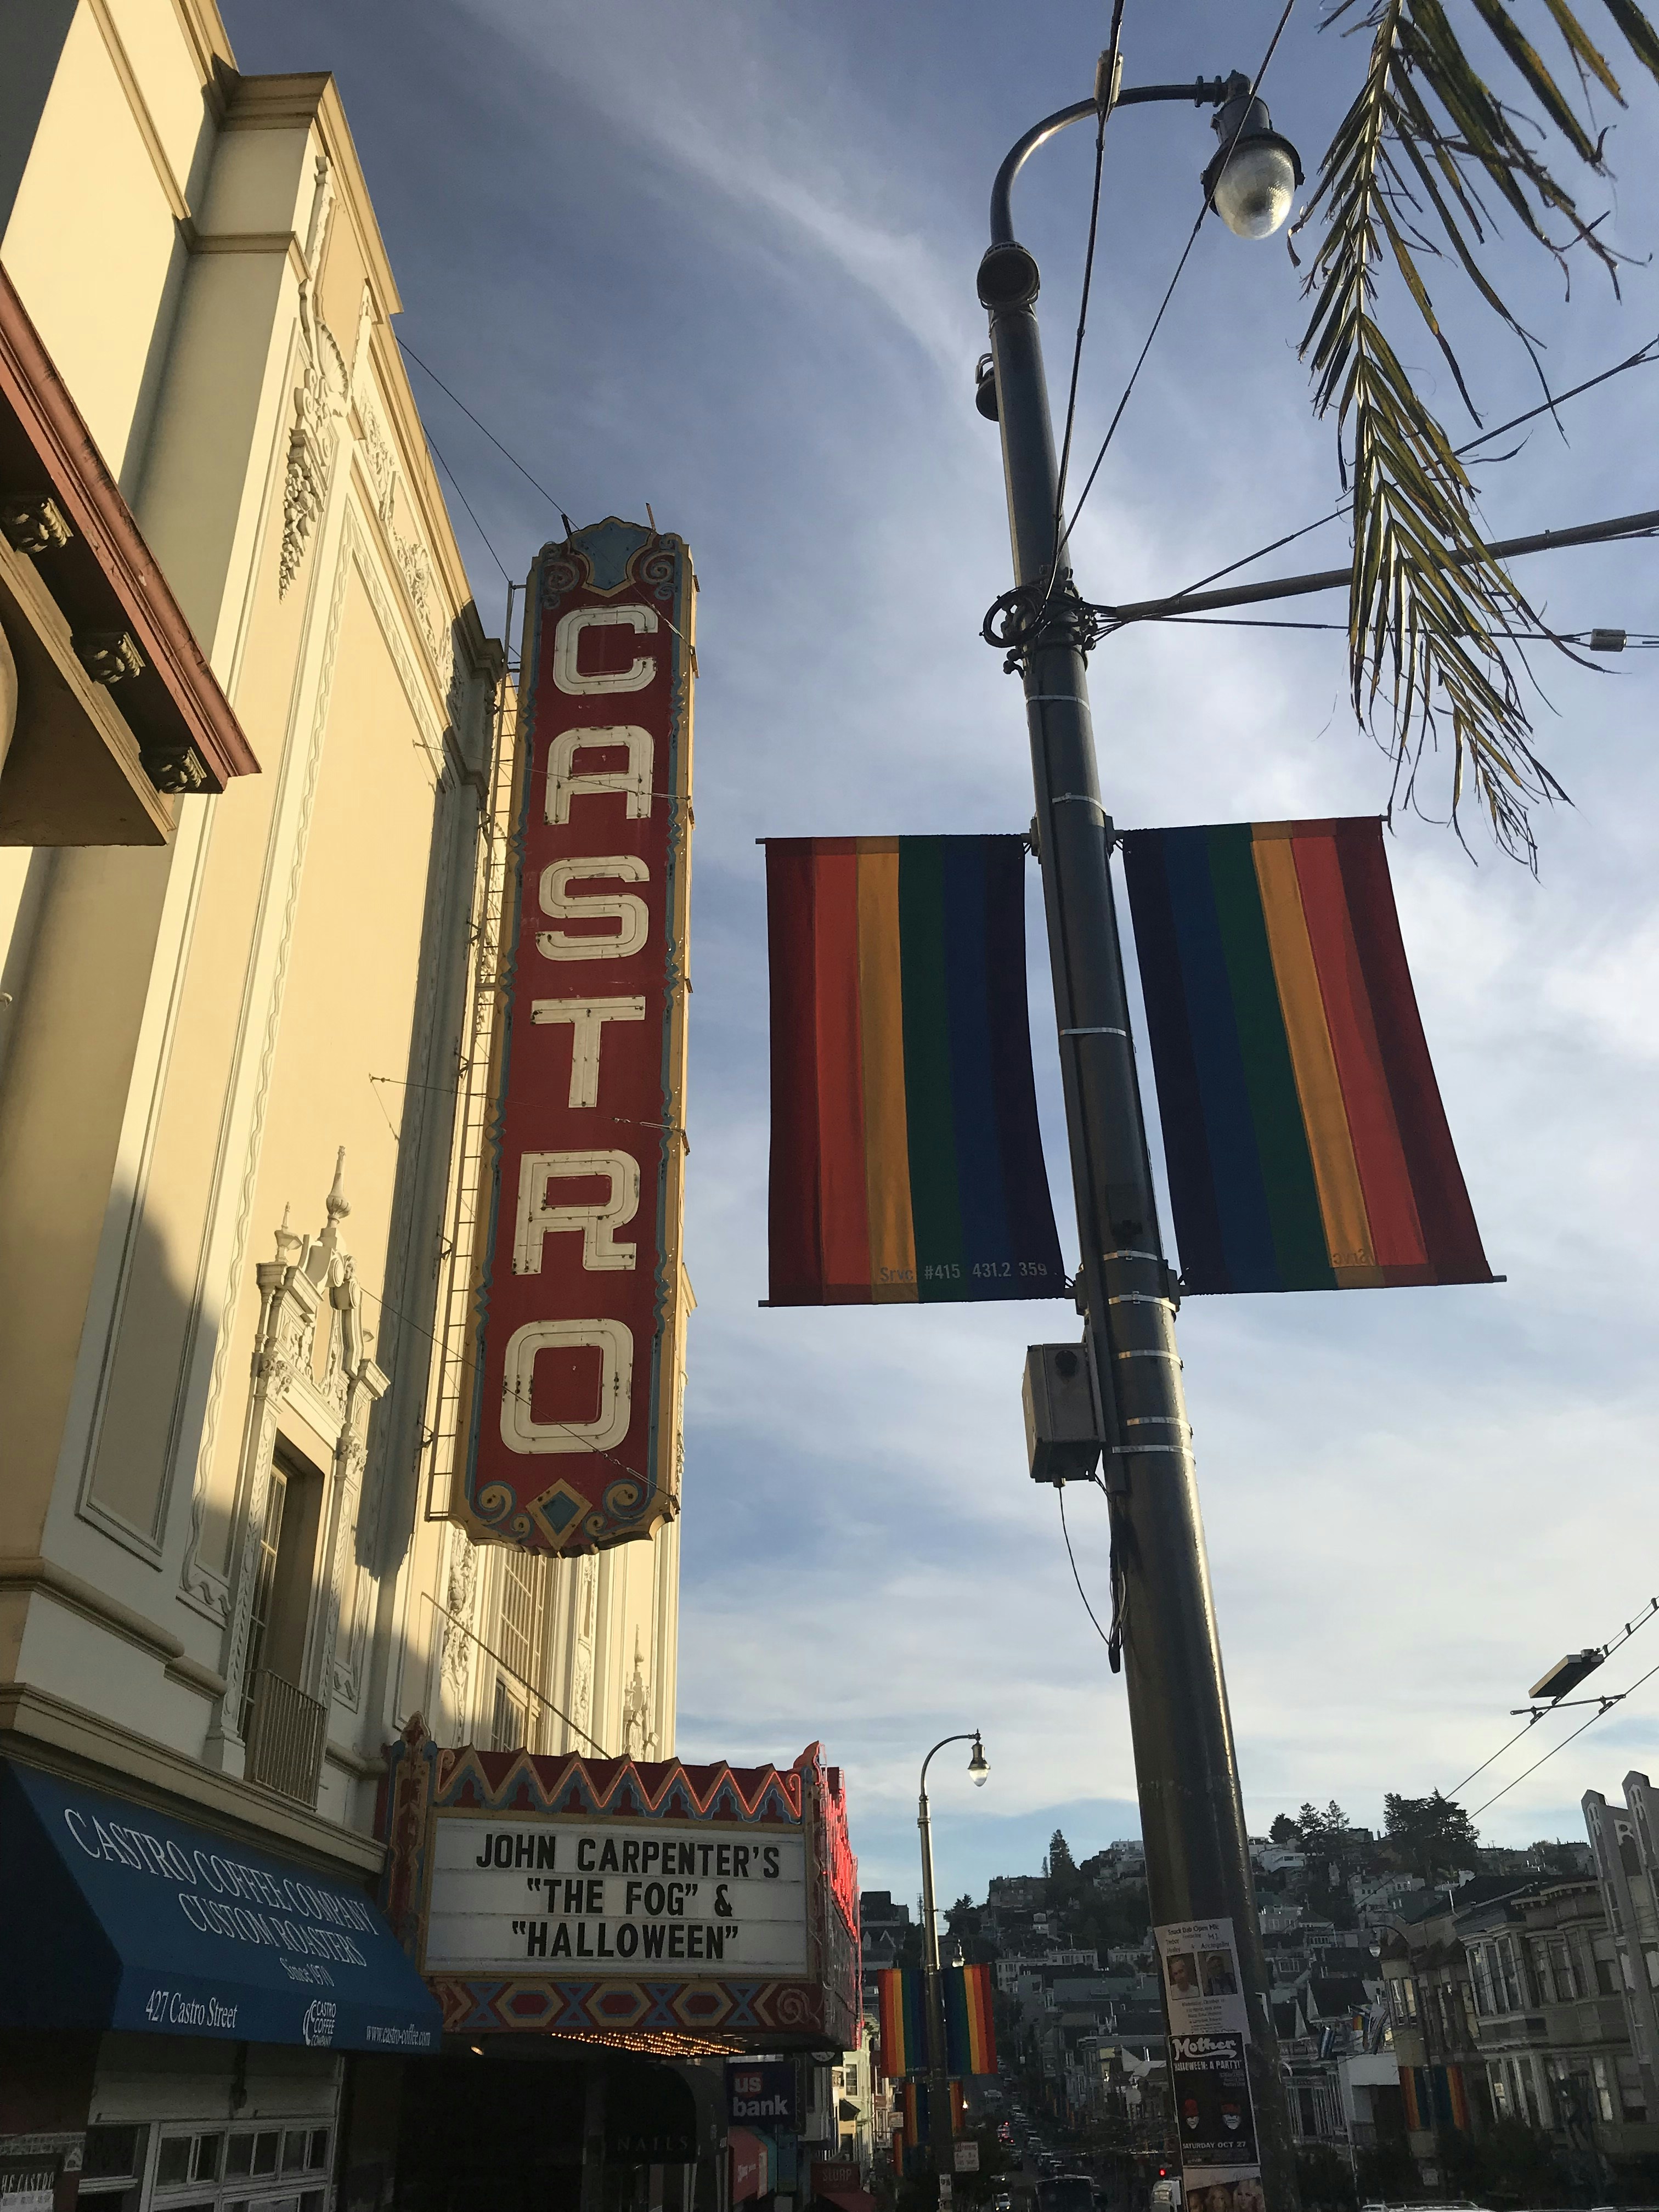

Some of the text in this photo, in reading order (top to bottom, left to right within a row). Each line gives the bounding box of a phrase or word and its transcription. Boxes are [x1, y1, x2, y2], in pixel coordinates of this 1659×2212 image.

[500, 604, 658, 1454] CASTRO
[879, 1267, 913, 1282] Srvc
[924, 1264, 961, 1279] #415
[1019, 1262, 1048, 1276] 359
[476, 1833, 780, 1878] JOHN CARPENTER'S
[65, 1808, 379, 1936] CASTRO COFFEE COMPANY
[527, 1878, 733, 1917] "THE FOG" &
[178, 1893, 366, 1967] CUSTOM ROASTERS
[512, 1921, 738, 1960] "HALLOWEEN"
[280, 1957, 313, 1983] Since
[145, 1989, 238, 2028] 427 Castro Street
[317, 2000, 337, 2018] CASTRO
[314, 2018, 336, 2034] COFFEE
[366, 2023, 431, 2046] www.castro-coffee.com
[1172, 2037, 1237, 2061] Mother
[733, 2076, 761, 2093] us
[733, 2095, 789, 2117] bank
[617, 2136, 687, 2152] NAILS
